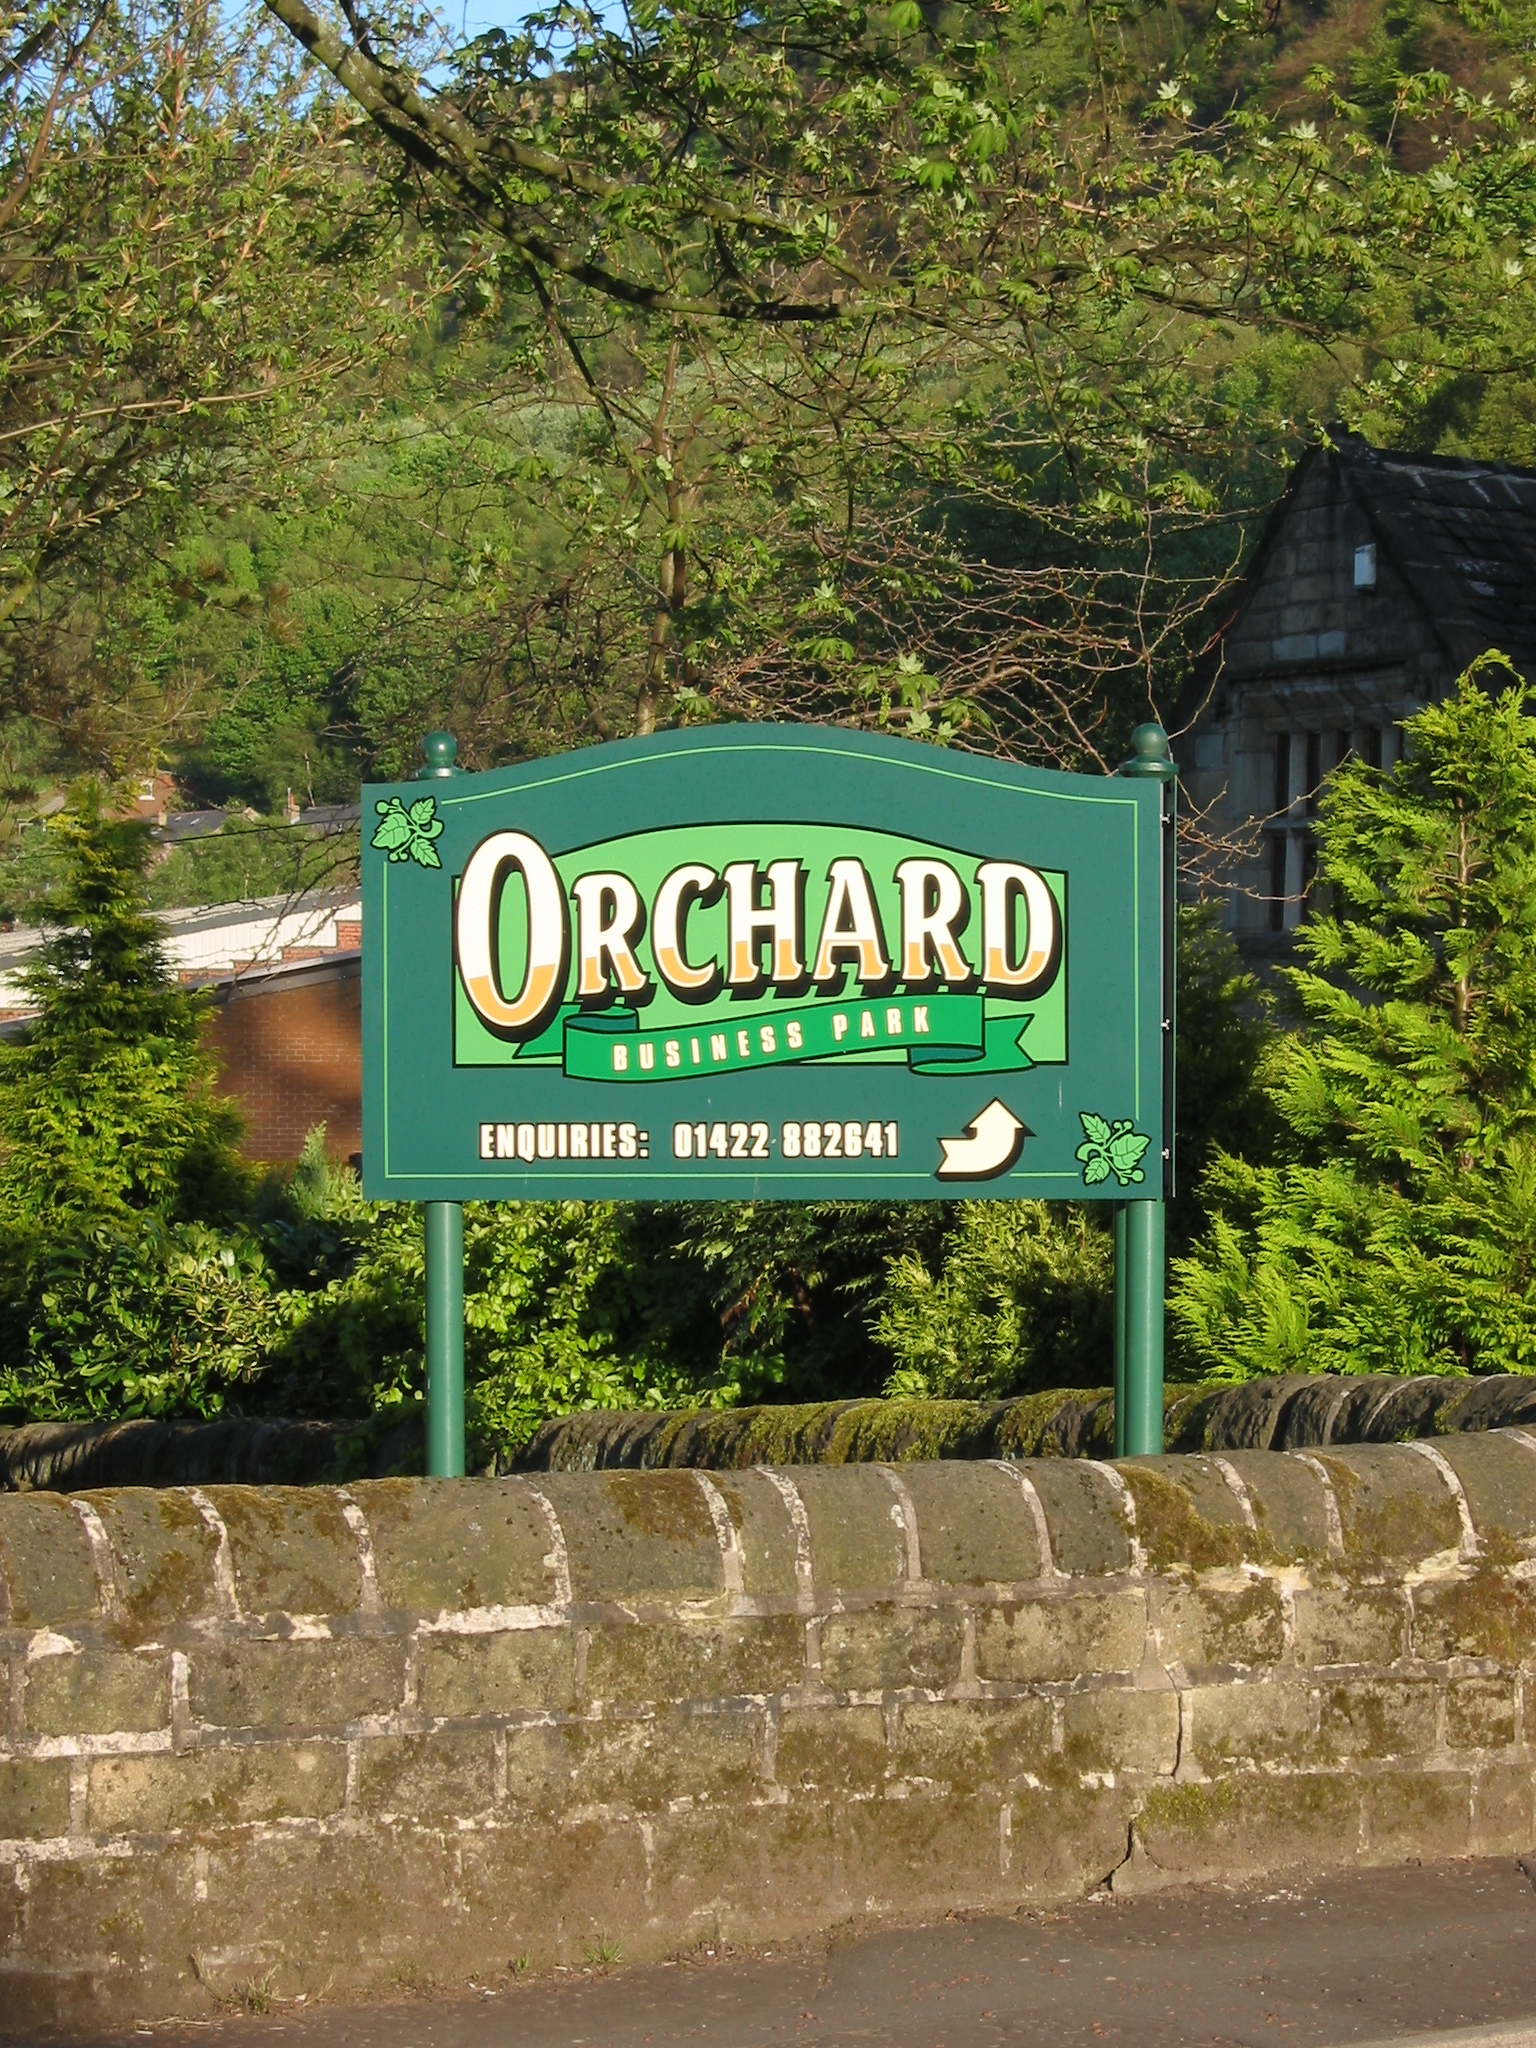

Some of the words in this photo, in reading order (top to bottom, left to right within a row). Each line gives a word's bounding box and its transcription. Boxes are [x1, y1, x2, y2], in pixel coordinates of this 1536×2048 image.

[456, 830, 1060, 1037] ORCHARD
[612, 1021, 804, 1073] BUSINESS
[833, 1005, 932, 1039] PARK
[479, 1122, 650, 1163] ENQUIRIES:
[673, 1121, 769, 1159] 01422
[782, 1121, 899, 1159] 882641
